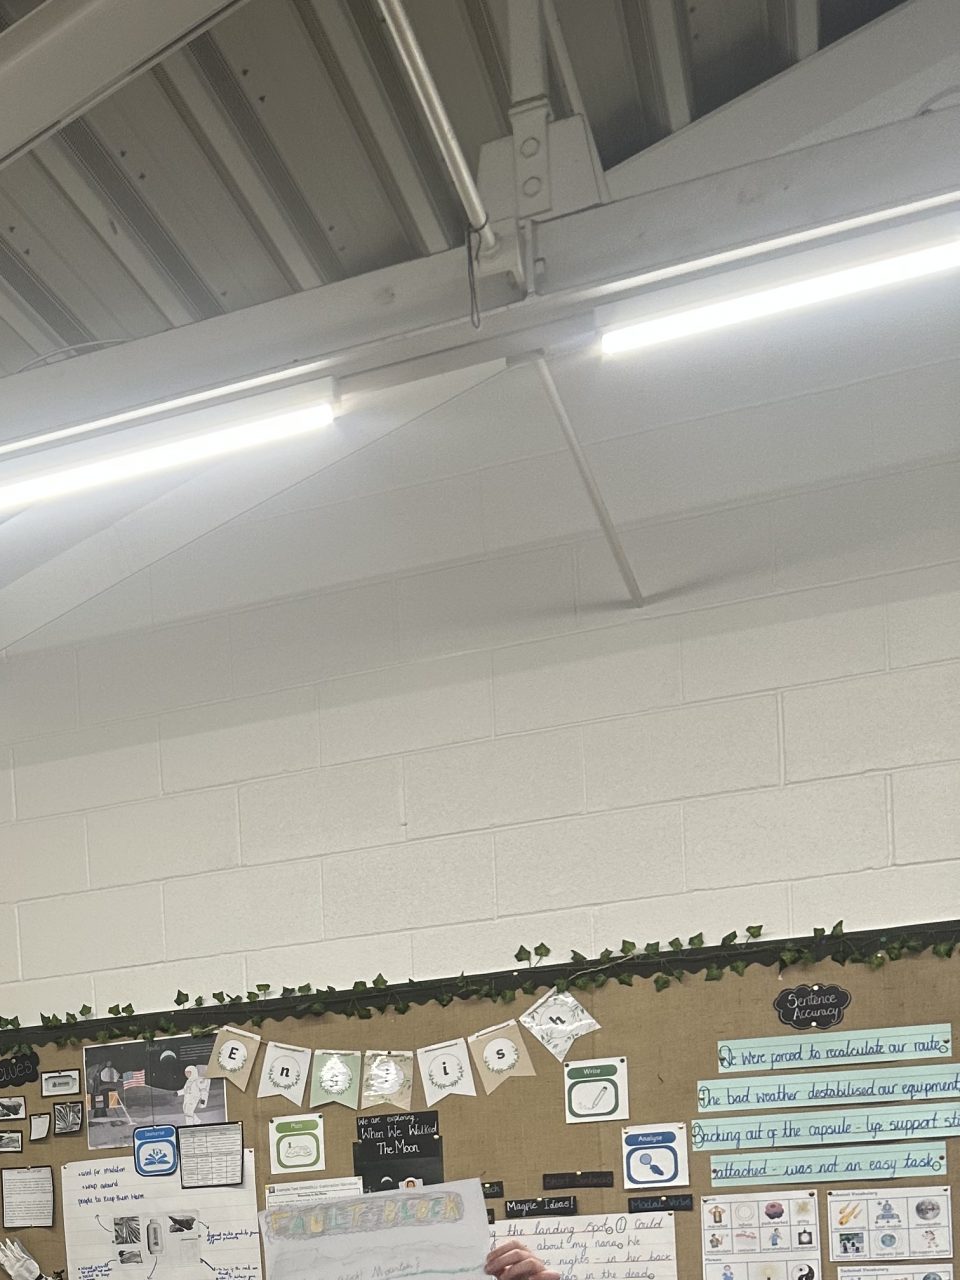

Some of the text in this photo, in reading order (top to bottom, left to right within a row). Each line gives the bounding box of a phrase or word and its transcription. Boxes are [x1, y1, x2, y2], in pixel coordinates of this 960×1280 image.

[787, 992, 838, 1009] Sentence
[793, 1006, 839, 1023] Accuracy
[771, 1043, 803, 1070] forced
[810, 1041, 821, 1059] to
[826, 1038, 885, 1059] recalculate
[888, 1042, 908, 1053] our
[584, 1067, 601, 1076] Write
[700, 1086, 721, 1108] The
[727, 1086, 750, 1105] bad
[756, 1084, 800, 1103] weather
[808, 1079, 877, 1100] destabilised
[878, 1083, 896, 1095] our
[358, 1116, 369, 1125] We
[361, 1123, 438, 1140] When We Walked
[638, 1135, 663, 1143] Analyse
[692, 1111, 960, 1149] Backing out of the capsule life support sti
[377, 1140, 420, 1155] The Moon
[715, 1160, 768, 1179] attached
[784, 1164, 813, 1176] was
[819, 1155, 838, 1174] not
[845, 1161, 862, 1171] an
[869, 1159, 897, 1180] easy
[507, 1197, 575, 1216] Magpie Ideas!
[630, 1200, 664, 1209] Modal
[271, 1194, 461, 1234] FAULT BLOCK
[507, 1224, 524, 1236] the
[534, 1220, 575, 1244] landing
[537, 1238, 566, 1251] about
[572, 1241, 588, 1257] my
[559, 1249, 673, 1275] nights in her back
[558, 1270, 578, 1280] tars
[585, 1271, 594, 1279] in
[600, 1269, 617, 1280] the
